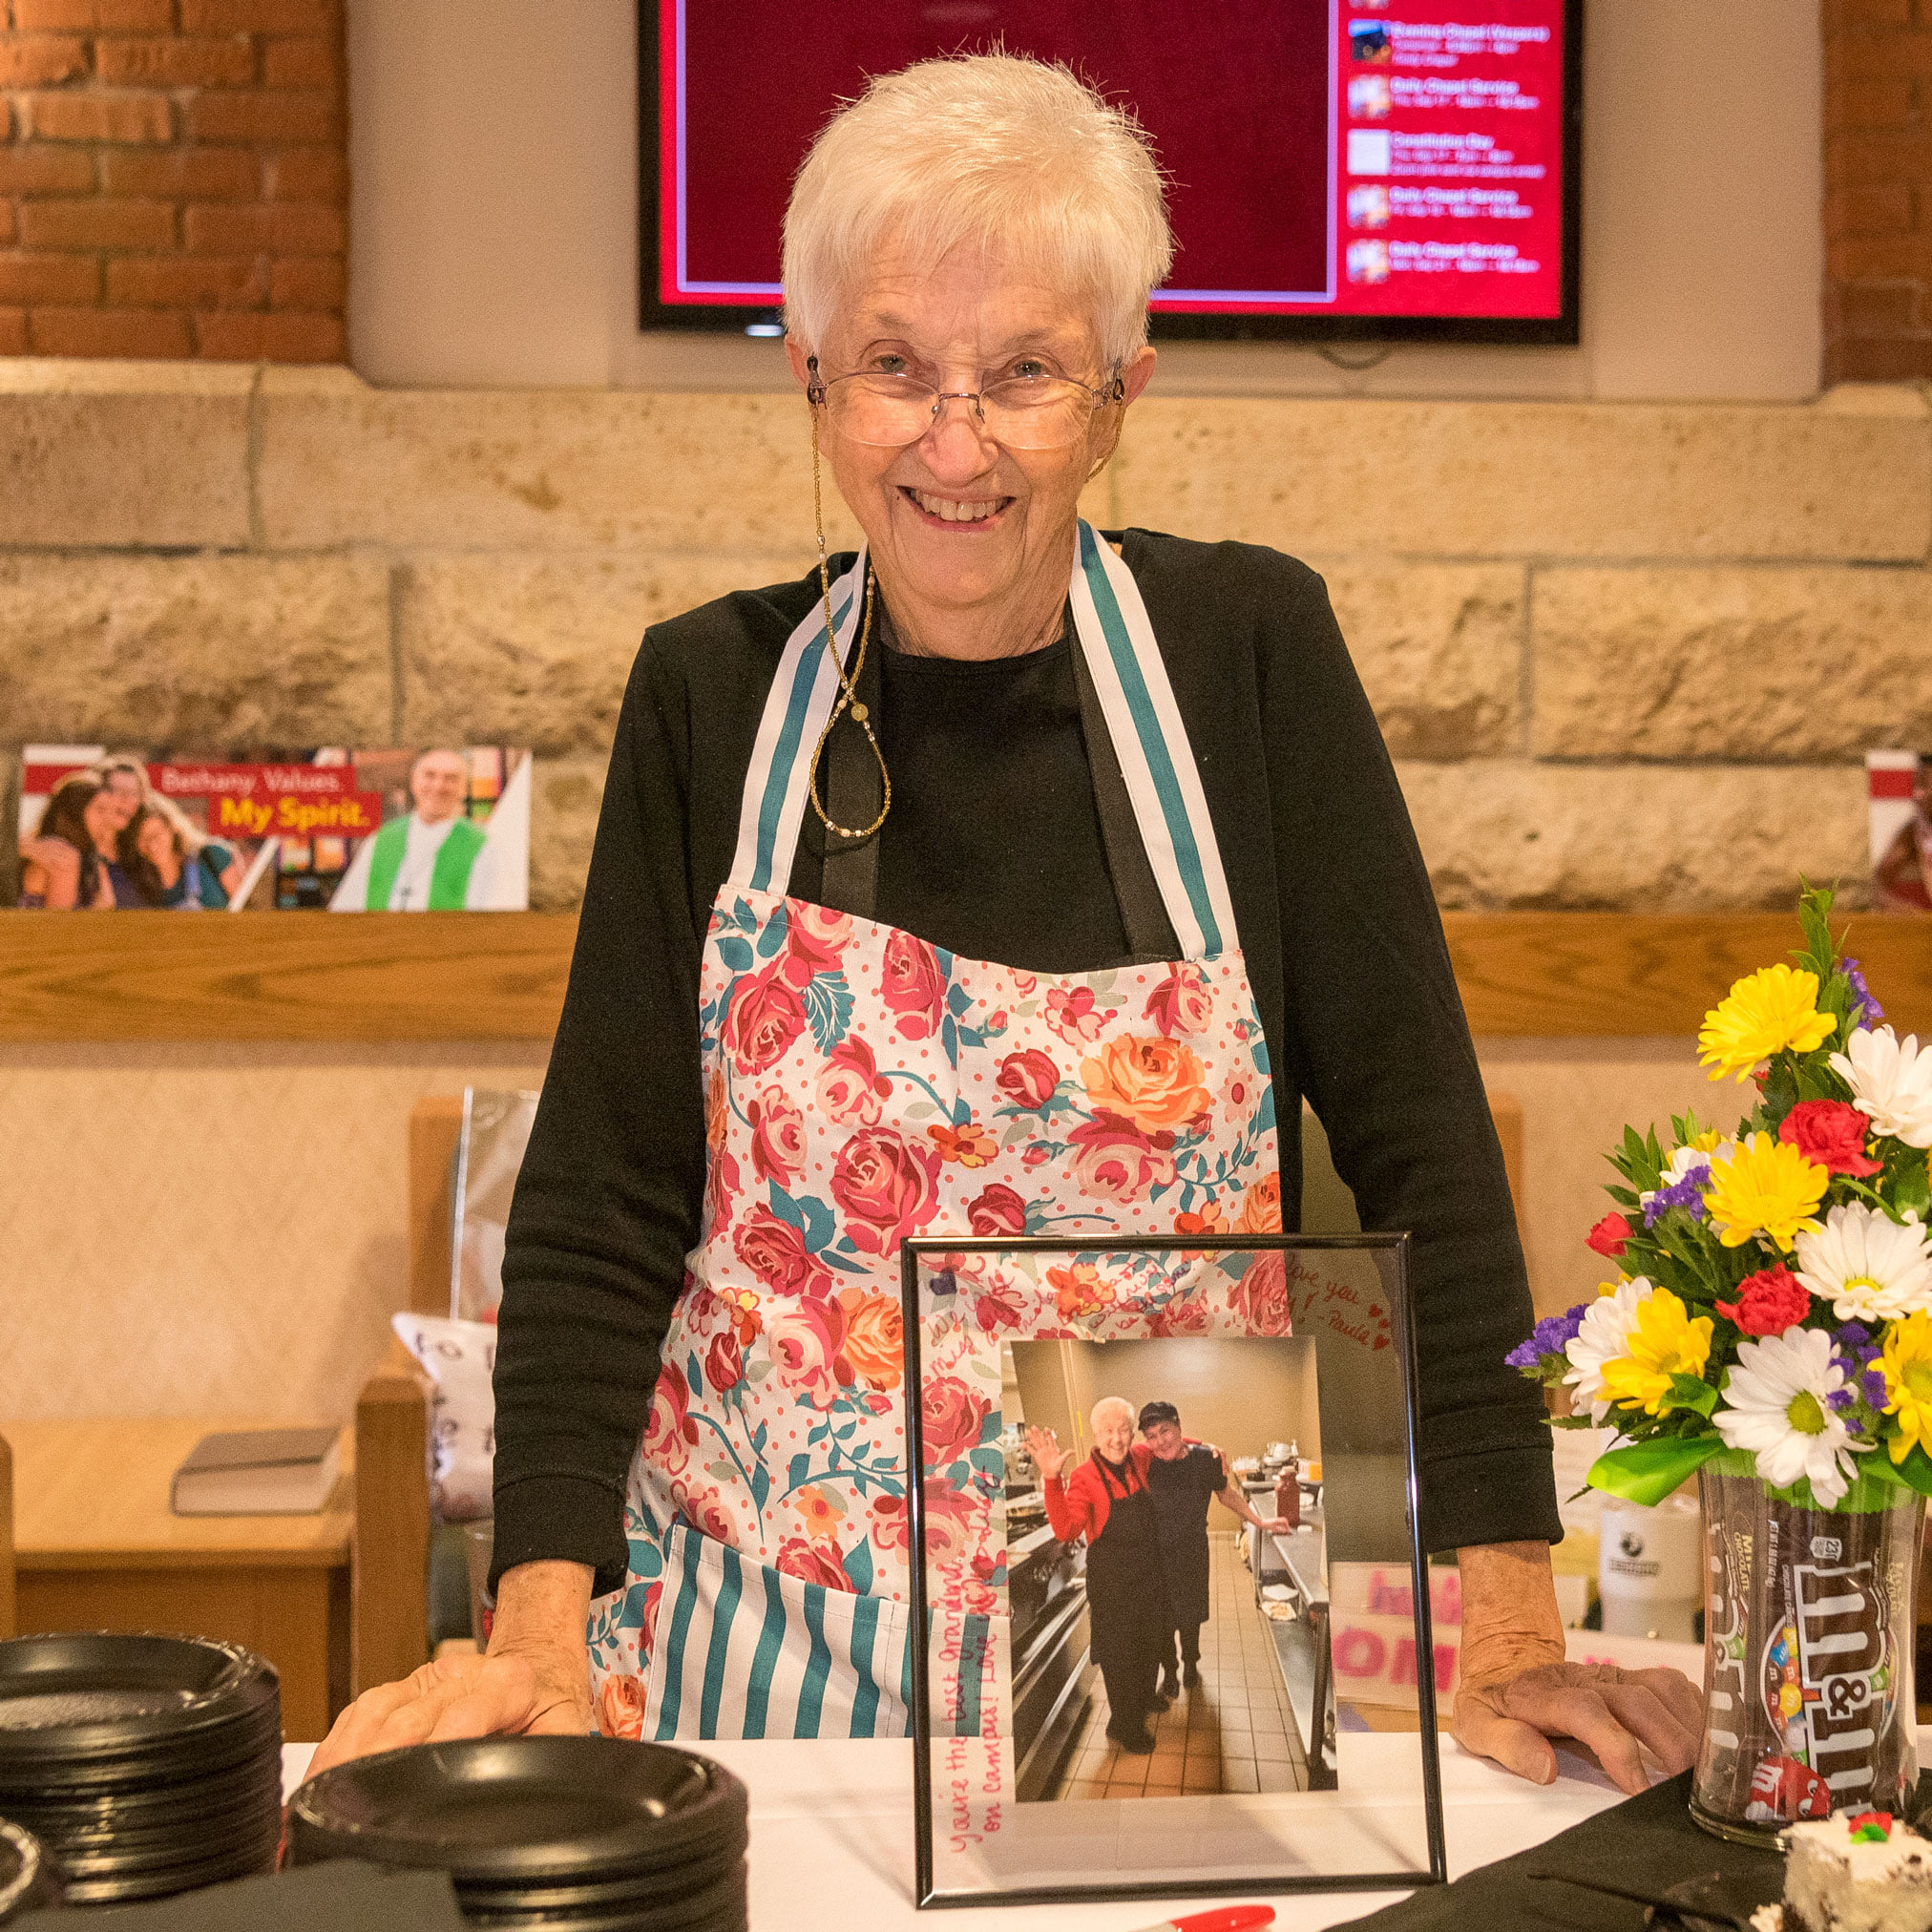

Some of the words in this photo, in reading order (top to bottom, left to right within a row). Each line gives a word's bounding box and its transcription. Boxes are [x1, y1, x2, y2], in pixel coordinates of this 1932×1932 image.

[161, 766, 257, 797] Bethany
[220, 798, 272, 833] My
[279, 797, 370, 832] Spirit.
[1733, 1531, 1750, 1591] CHOCOLATE
[941, 1671, 967, 1722] best
[945, 1735, 968, 1772] the
[1751, 1762, 1783, 1793] m
[983, 1801, 1002, 1834] on
